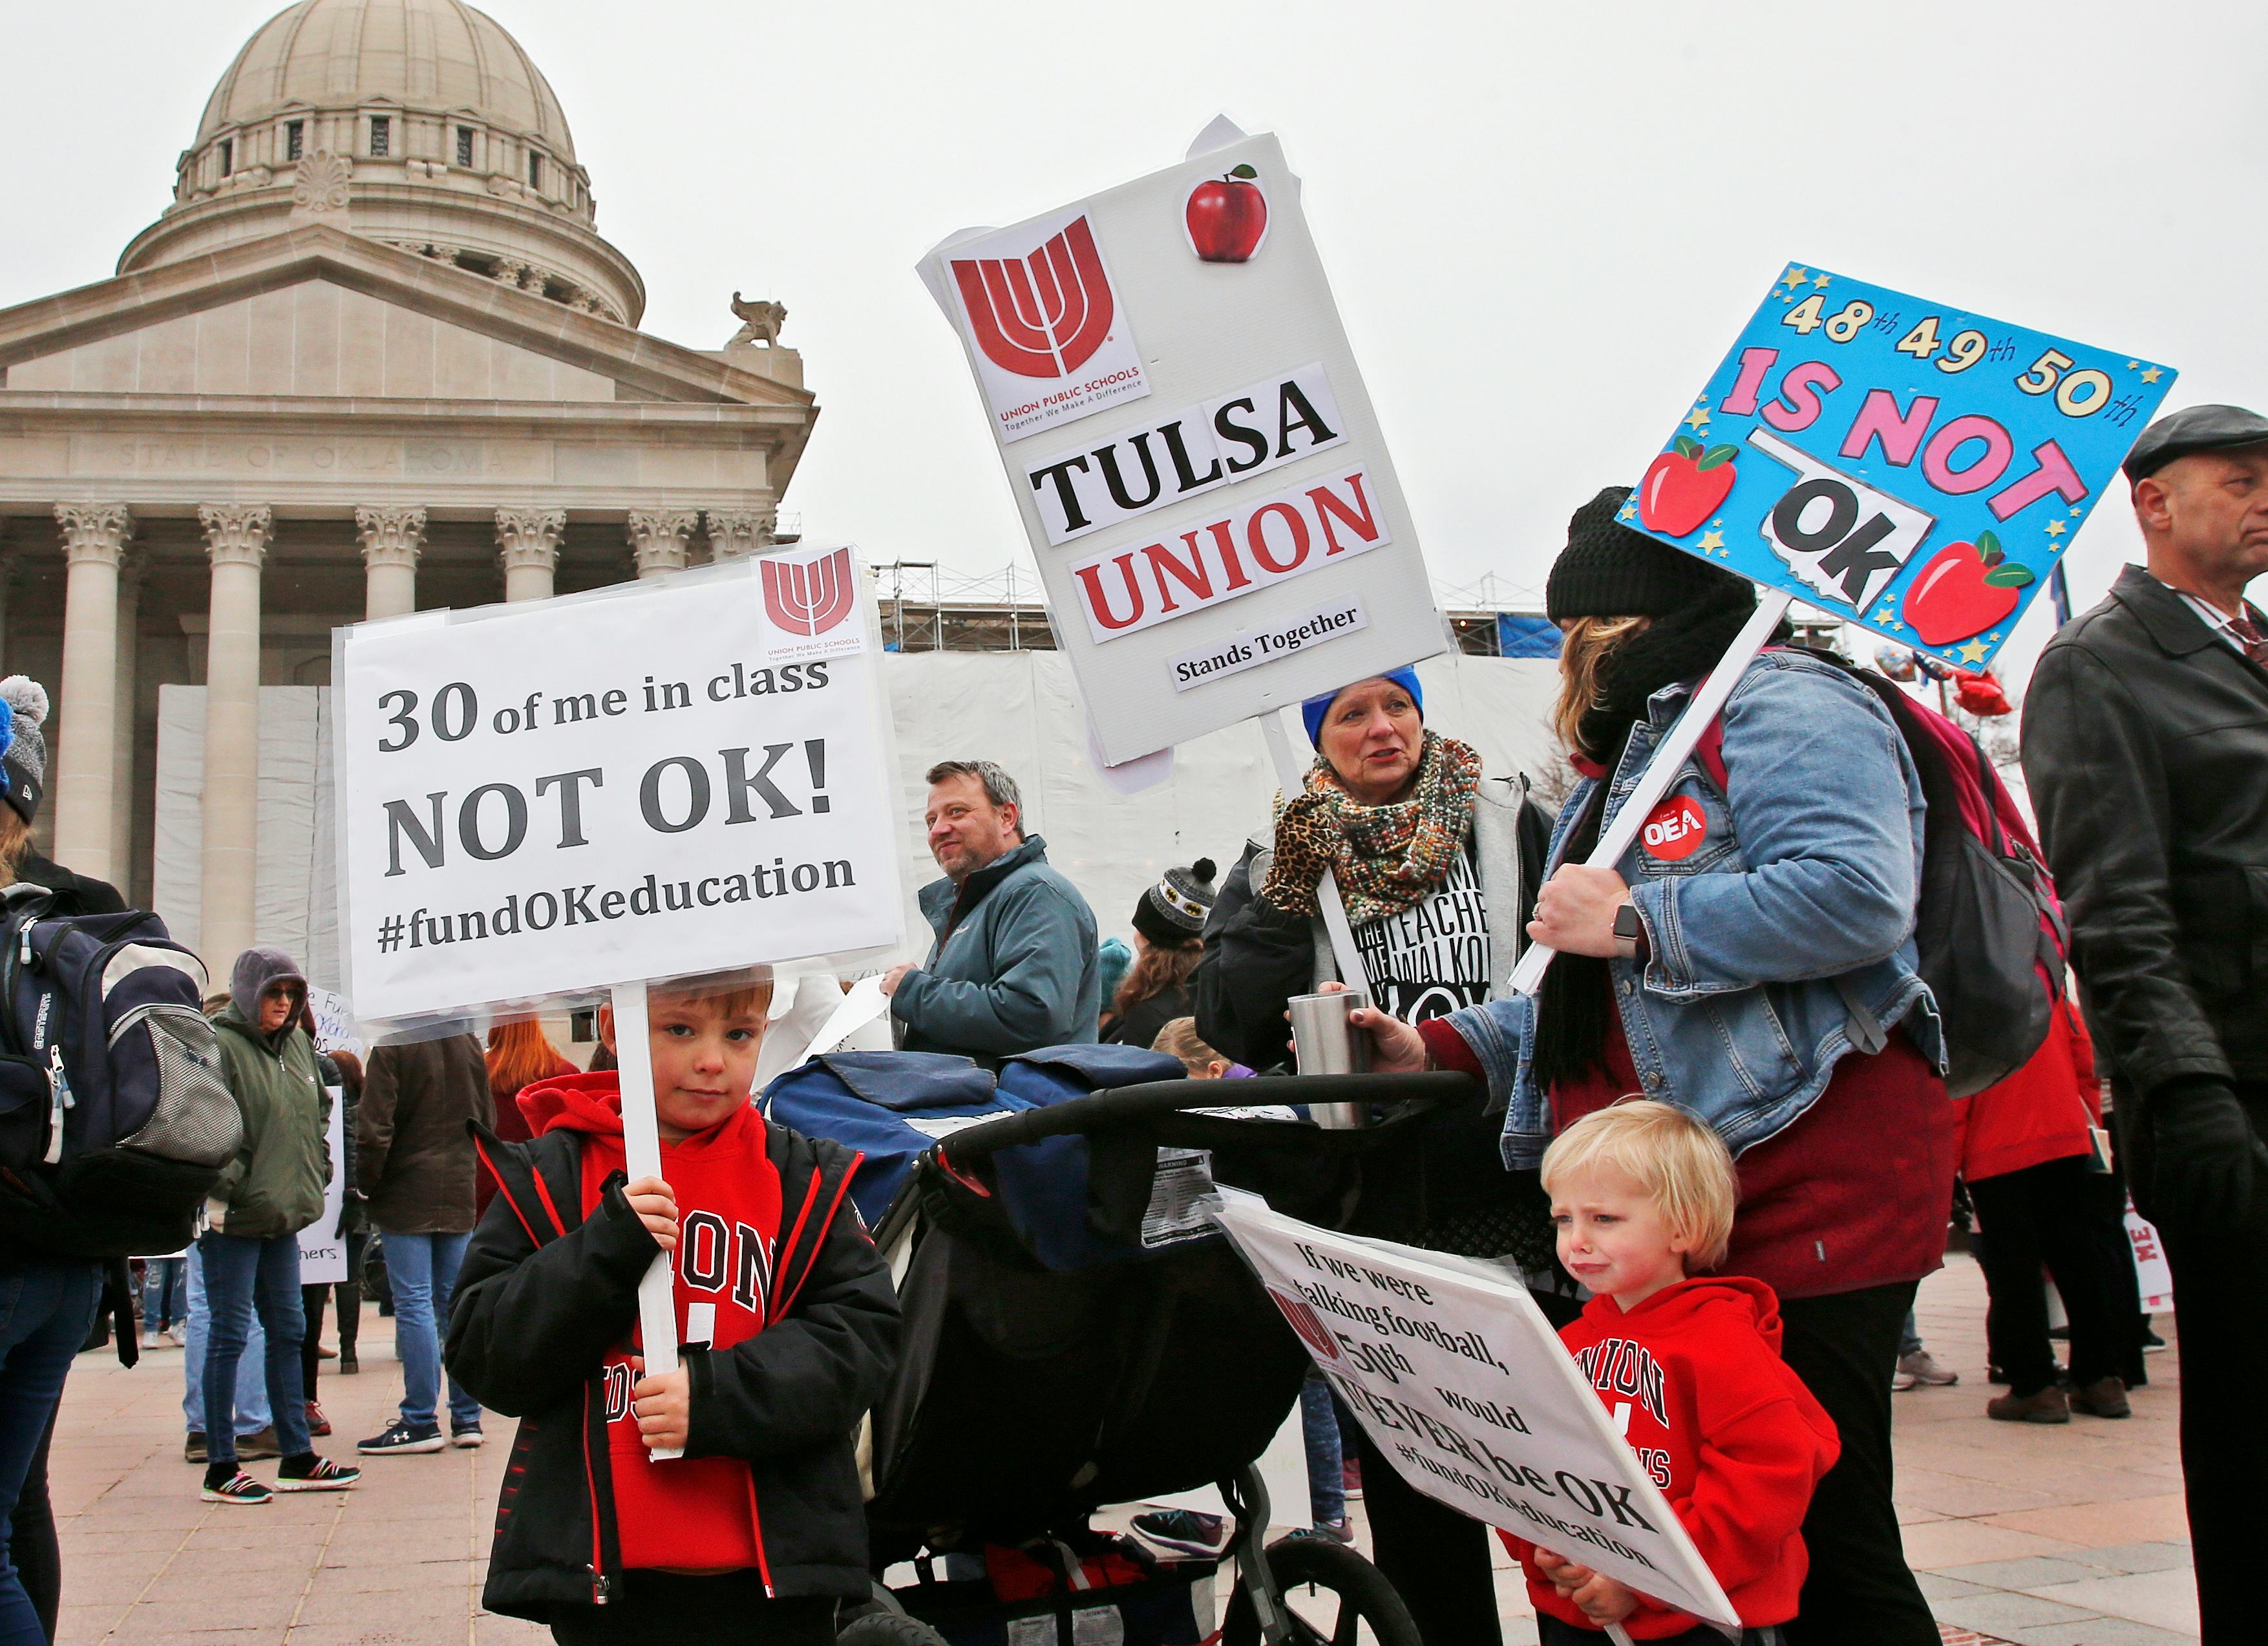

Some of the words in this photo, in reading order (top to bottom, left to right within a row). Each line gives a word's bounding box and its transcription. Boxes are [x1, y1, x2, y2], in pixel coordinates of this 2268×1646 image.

[1001, 401, 1040, 422] UNION
[1043, 387, 1082, 407] PUBLIC
[1085, 367, 1139, 392] SCHOOLS
[1005, 415, 1043, 431] Together
[1046, 409, 1059, 418] We
[1062, 400, 1085, 412] Make
[1096, 380, 1141, 400] Difference
[1781, 294, 1900, 343] 48th
[1894, 316, 2015, 374] 49th
[2013, 347, 2144, 427] 50th
[1030, 380, 1337, 533] TULSA
[1719, 347, 1843, 433] IS
[1839, 389, 2090, 523] NOT
[1075, 472, 1379, 630] UNION
[768, 647, 794, 656] UNION
[796, 643, 821, 652] PUBLIC
[825, 637, 860, 647] SCHOOLS
[1176, 645, 1252, 681] Stands
[1255, 608, 1357, 649] Together
[379, 682, 477, 752] 30
[493, 692, 542, 734] of
[552, 689, 628, 725] me
[644, 676, 693, 712] in
[708, 661, 829, 703] class
[383, 767, 604, 878] NOT
[639, 738, 831, 834] OK!
[1644, 809, 1702, 846] OEA
[377, 857, 856, 954] #fundOKeducation
[1293, 1242, 1322, 1270] If
[1320, 1255, 1361, 1283] we
[1360, 1267, 1434, 1305] were
[1293, 1279, 1389, 1336] talking
[1382, 1306, 1510, 1375] football,
[1333, 1330, 1417, 1384] 50th
[1434, 1387, 1532, 1435] would
[1573, 1338, 1669, 1430] NION
[1332, 1373, 1490, 1472] NEVER
[1474, 1438, 1556, 1497] be
[1554, 1470, 1659, 1534] OK
[1395, 1442, 1657, 1571] #fundOKeducation
